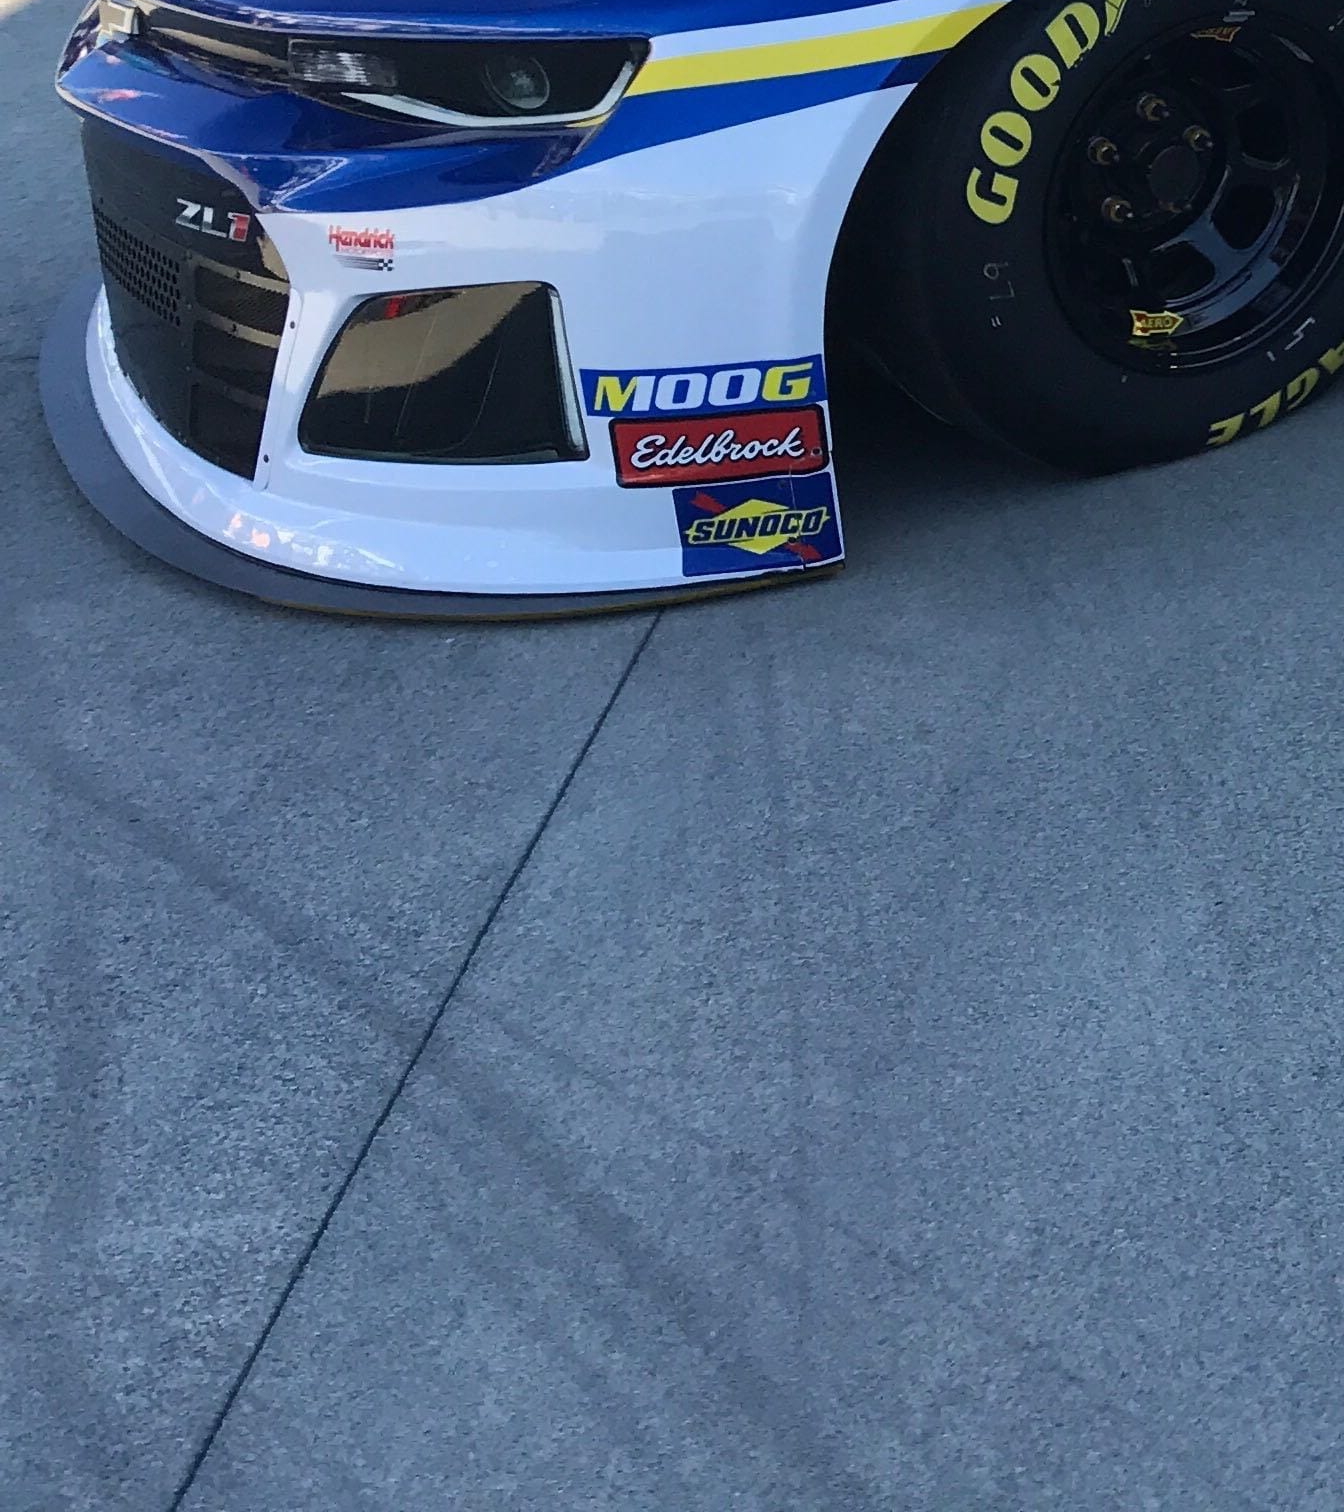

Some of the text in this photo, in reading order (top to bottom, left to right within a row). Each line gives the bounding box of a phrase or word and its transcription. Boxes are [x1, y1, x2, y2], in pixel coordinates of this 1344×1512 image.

[176, 198, 250, 242] ZL1
[329, 225, 394, 252] Hendrick
[593, 362, 814, 412] MOOG
[631, 427, 805, 468] Edelbrock
[694, 508, 824, 542] SUNOCO
